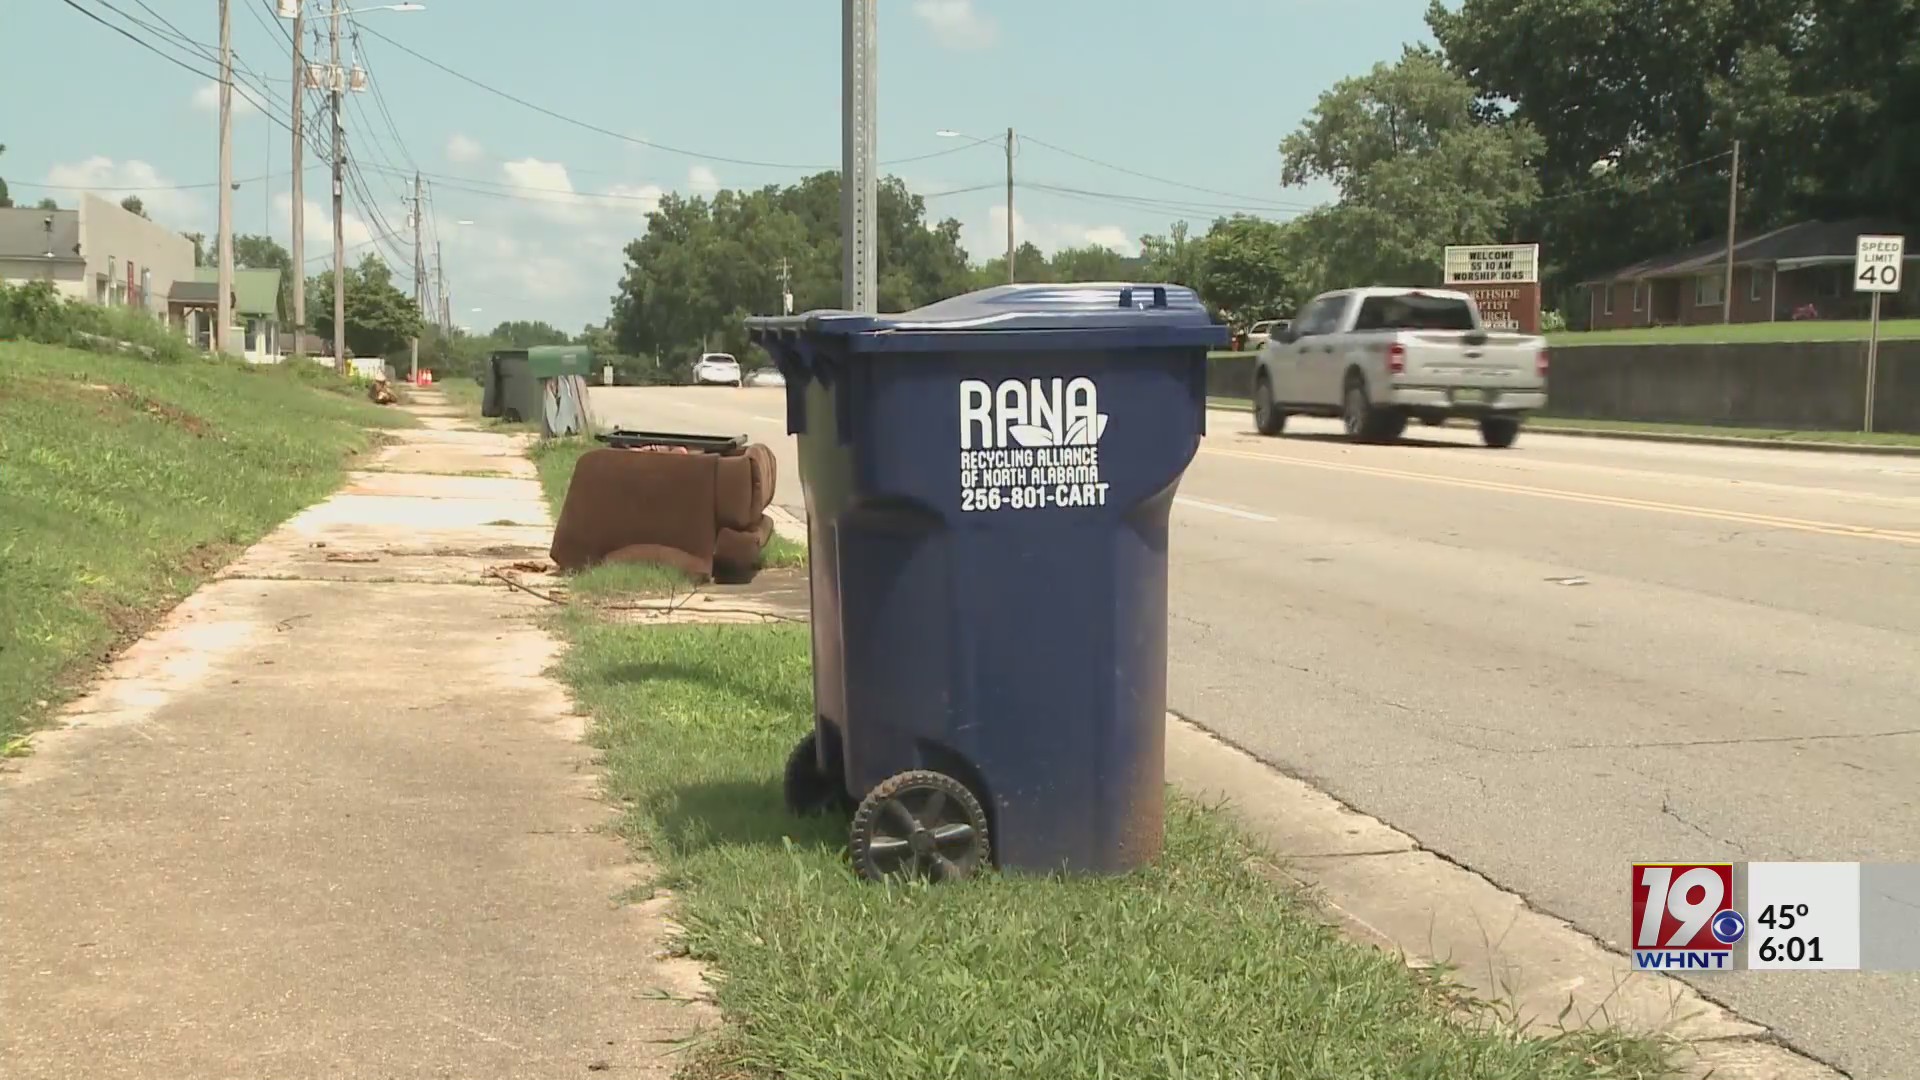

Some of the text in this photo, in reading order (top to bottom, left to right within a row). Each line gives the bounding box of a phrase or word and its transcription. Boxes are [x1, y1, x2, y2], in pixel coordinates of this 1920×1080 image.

[1861, 241, 1900, 252] SPEED
[1469, 251, 1514, 260] WELCOME
[1864, 253, 1894, 263] LIMIT
[1486, 261, 1496, 270] 10
[1498, 261, 1512, 270] AM
[1453, 271, 1524, 281] WORSHIP 1045
[1858, 265, 1897, 285] 40
[1472, 289, 1520, 300] RTHSIDE
[1479, 301, 1509, 310] PTIST
[1483, 311, 1511, 321] URCH
[960, 377, 1098, 449] RANA
[960, 447, 1098, 469] RECYCLING ALLIANCE
[961, 466, 1099, 488] OF NORTH ALABAMA
[961, 483, 1110, 511] 256-801-CART
